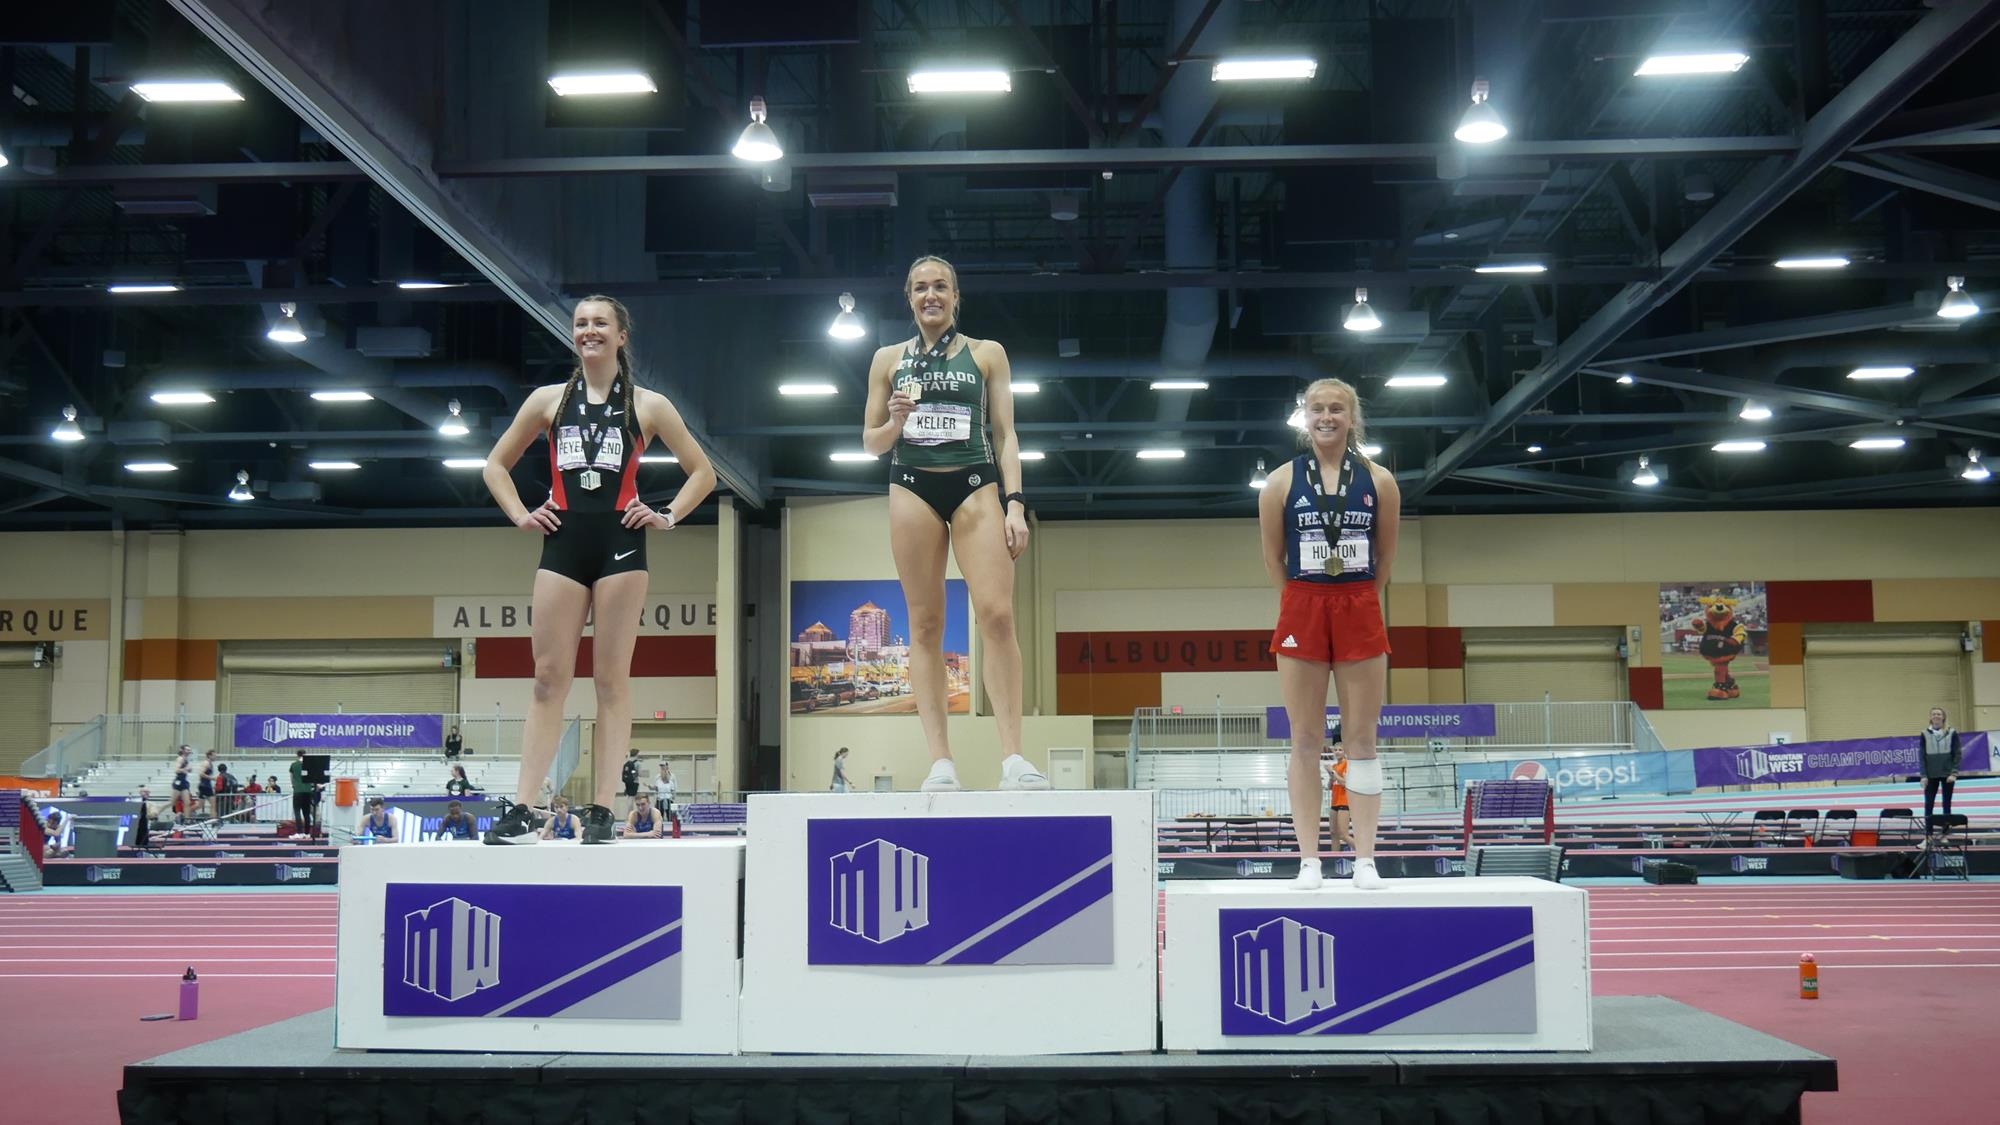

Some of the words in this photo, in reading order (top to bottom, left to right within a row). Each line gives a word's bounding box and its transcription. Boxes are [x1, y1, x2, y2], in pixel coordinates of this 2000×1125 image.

[897, 371, 976, 389] COORADO
[920, 381, 959, 391] TATE
[917, 416, 956, 430] KELLER
[558, 441, 621, 455] FEYEEND
[1343, 511, 1373, 527] STATE
[453, 603, 717, 630] ALBQUE
[1377, 715, 1461, 726] AMPIONSHIPS
[288, 728, 316, 739] WEST
[319, 725, 415, 737] CHAMPIONSHIP
[1768, 753, 1804, 762] MOUNTAIN
[1768, 761, 1804, 773] WEST
[1555, 760, 1637, 793] pepsi
[197, 871, 215, 879] WEST
